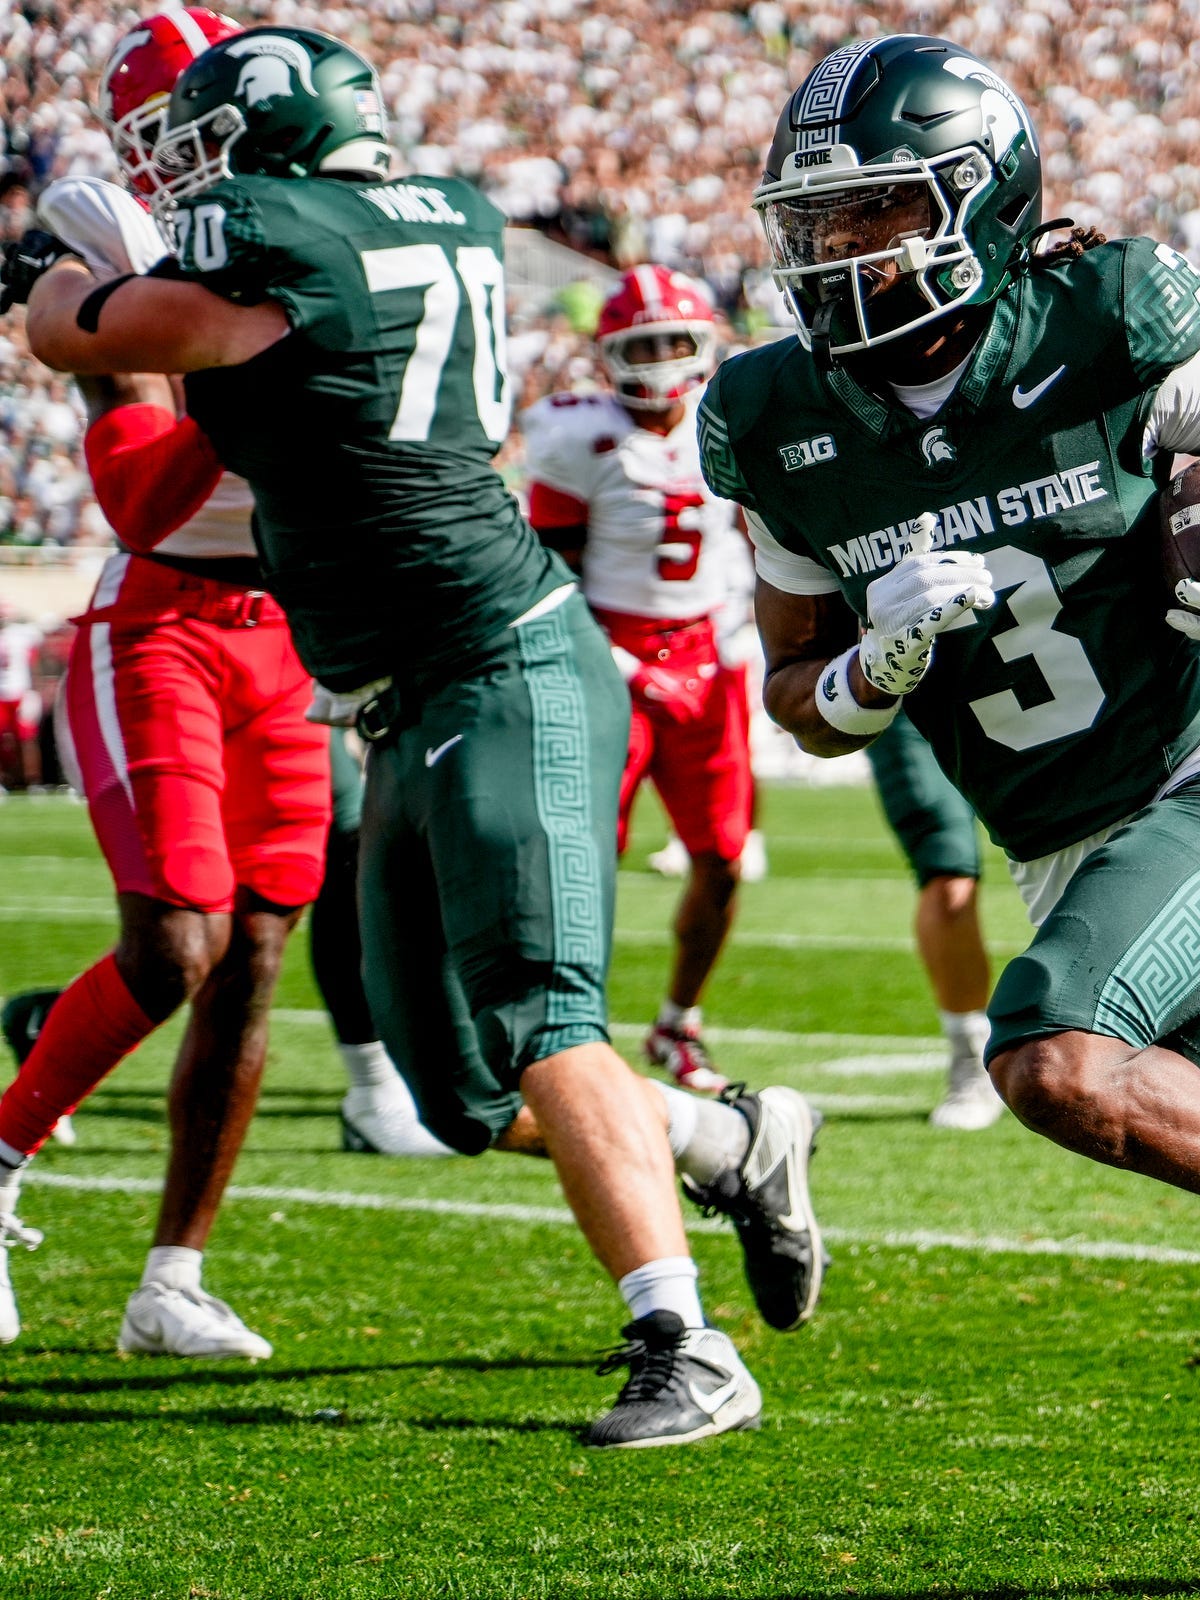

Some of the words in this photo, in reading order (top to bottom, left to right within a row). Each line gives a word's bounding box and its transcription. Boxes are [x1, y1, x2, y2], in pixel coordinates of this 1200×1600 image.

[794, 147, 833, 169] STATE
[361, 243, 512, 442] 70
[996, 460, 1108, 526] STATE
[943, 544, 1107, 752] 3
